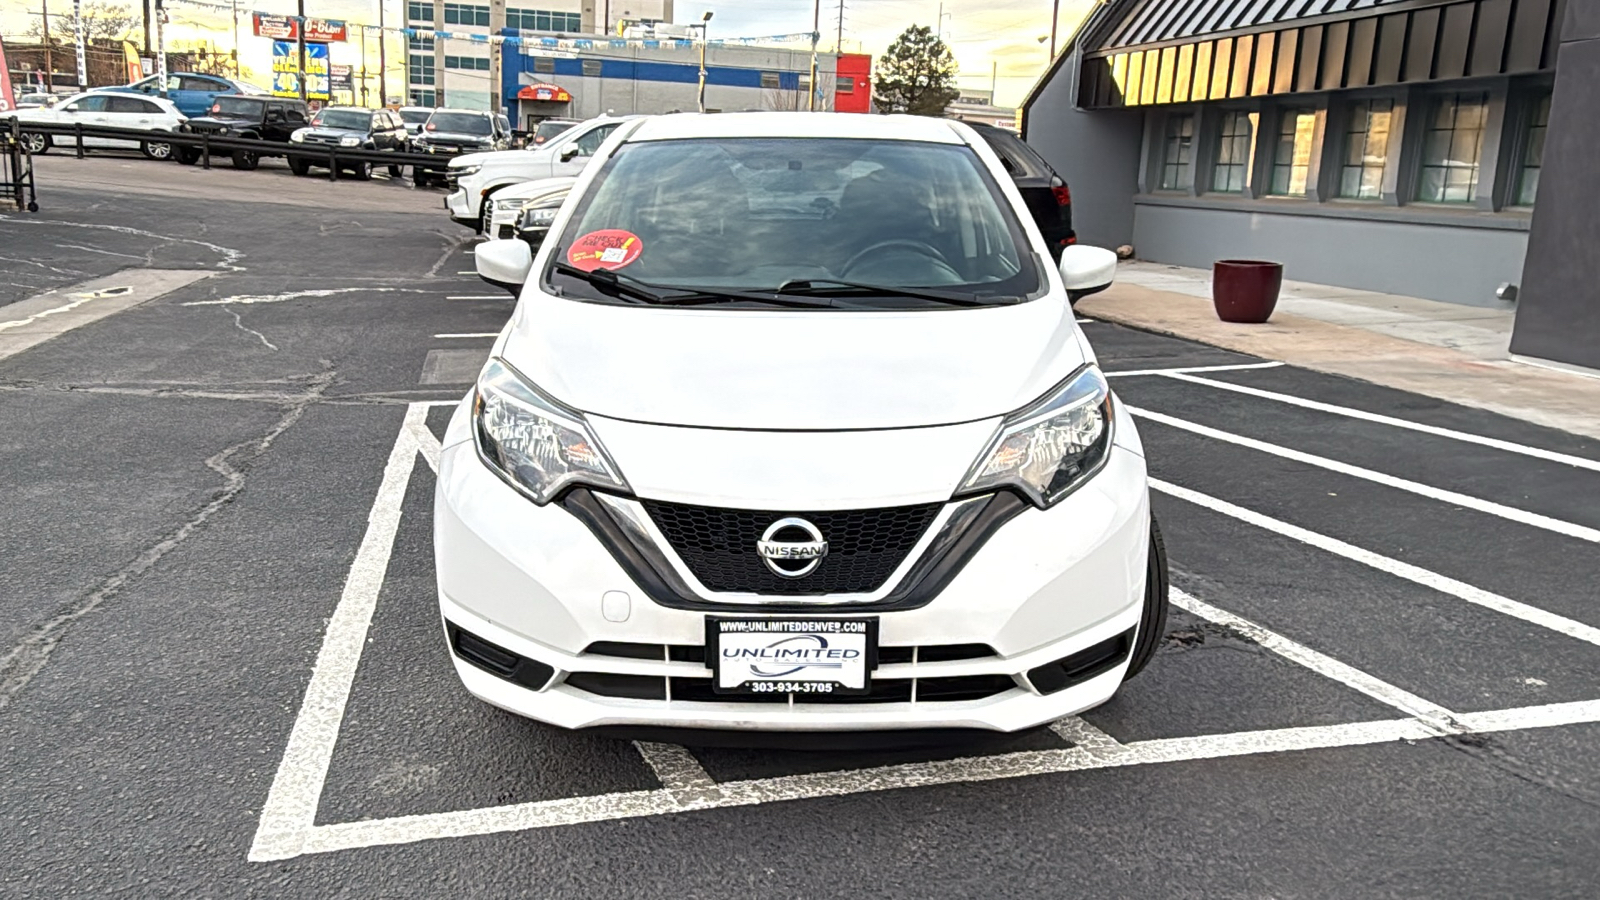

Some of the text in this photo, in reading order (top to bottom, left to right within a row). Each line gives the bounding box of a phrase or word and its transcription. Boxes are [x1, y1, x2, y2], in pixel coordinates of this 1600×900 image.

[585, 235, 623, 243] CHECK
[764, 545, 821, 556] NISSAN
[719, 621, 866, 632] WWW.UNLIMITEDDENVER.COM
[722, 648, 860, 658] UNLIMITED
[752, 682, 832, 692] 303-934-3705
